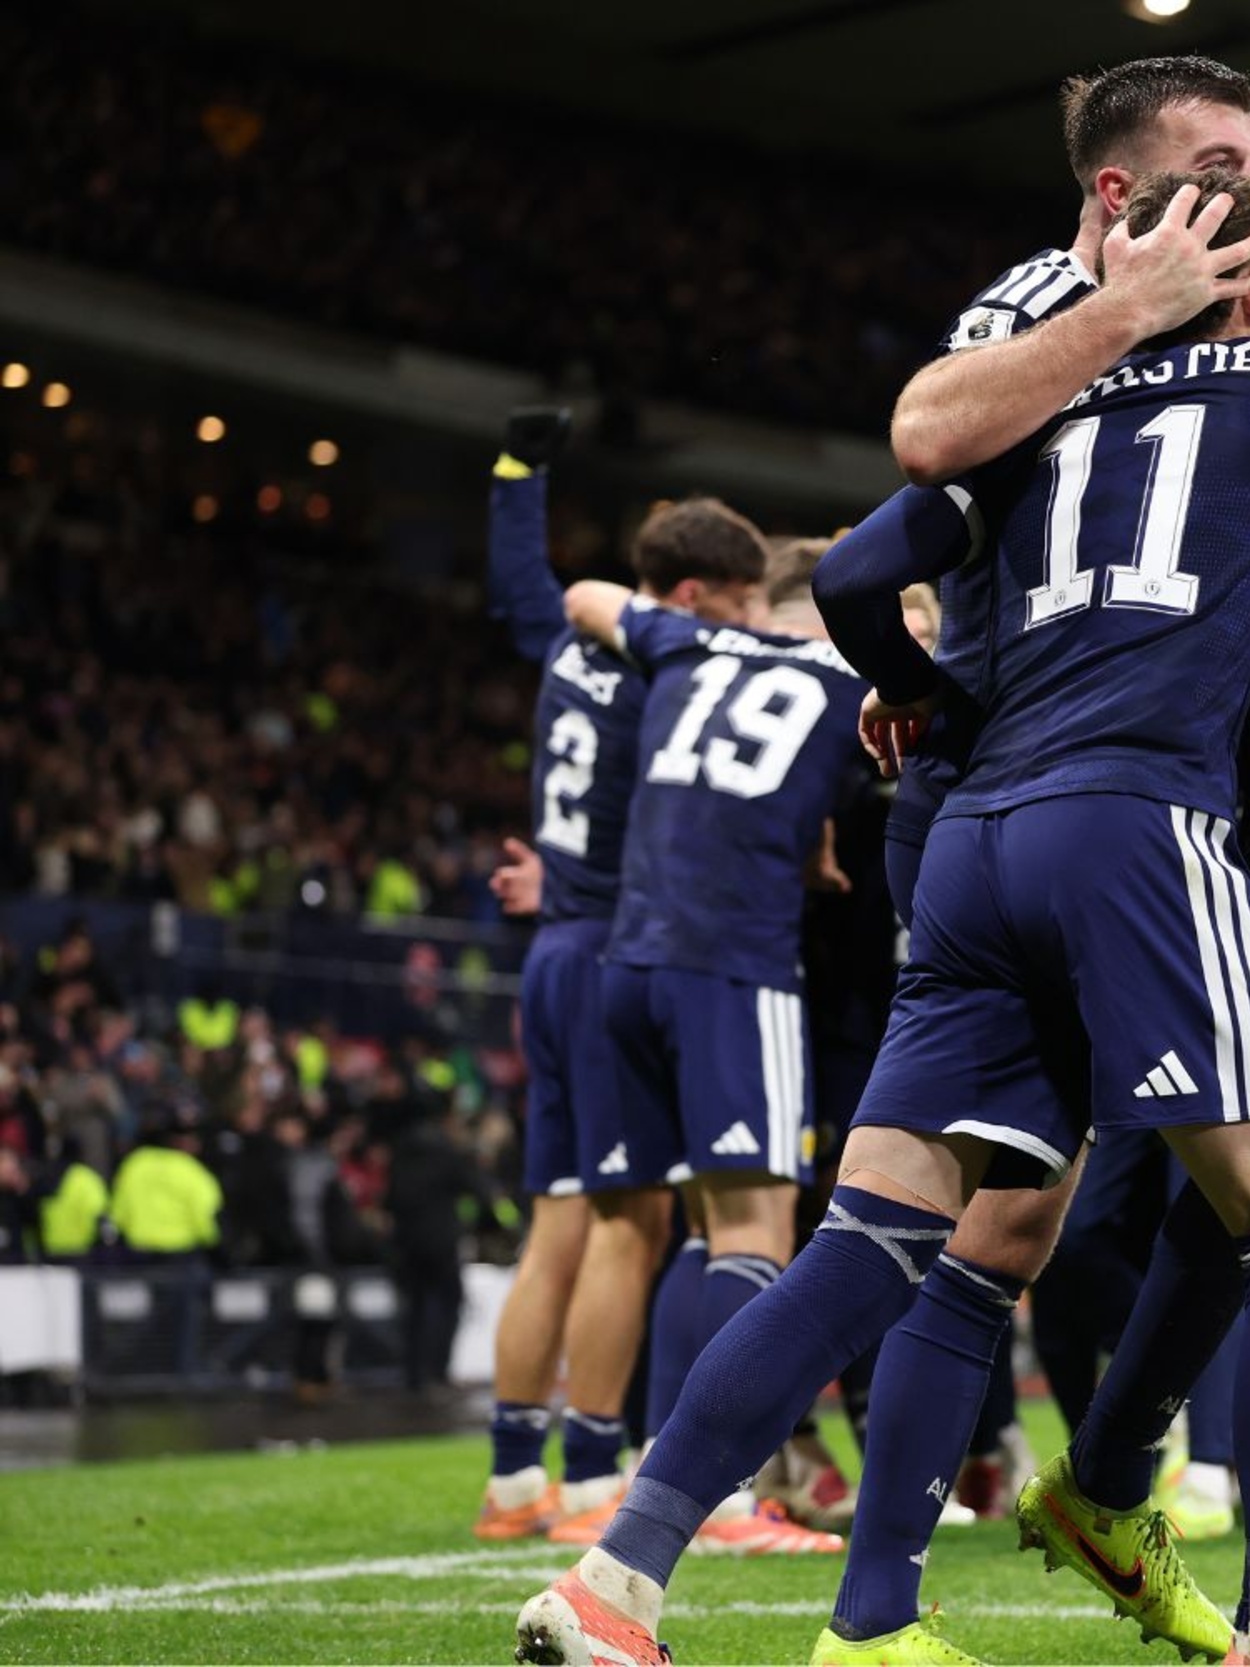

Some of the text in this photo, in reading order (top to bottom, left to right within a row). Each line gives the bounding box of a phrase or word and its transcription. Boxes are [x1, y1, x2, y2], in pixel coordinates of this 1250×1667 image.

[1024, 404, 1206, 630] 11
[537, 710, 598, 858] 2
[646, 653, 828, 799] 19
[926, 1476, 948, 1506] AL
